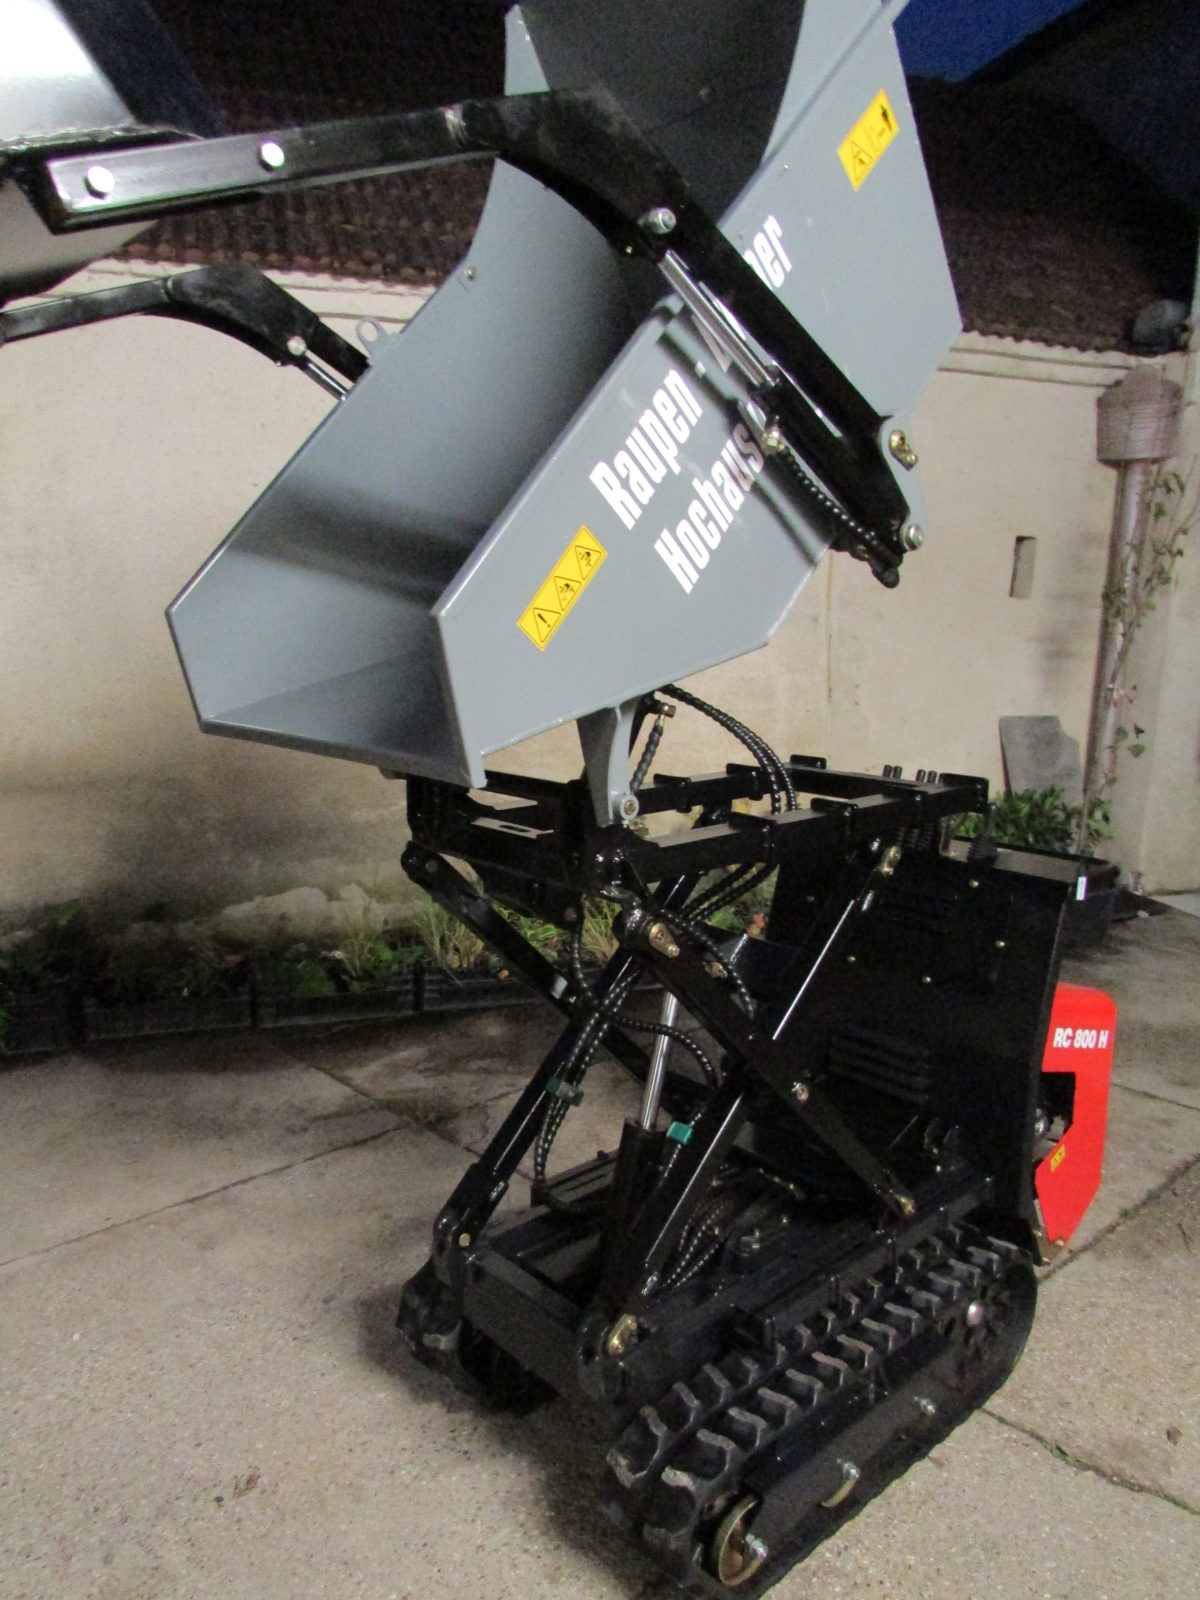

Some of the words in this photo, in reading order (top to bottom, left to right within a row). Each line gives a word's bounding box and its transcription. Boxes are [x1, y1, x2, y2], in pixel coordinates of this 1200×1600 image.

[589, 369, 703, 531] Raupen
[654, 424, 764, 594] Hochaus
[1053, 1026, 1073, 1048] RC
[1073, 1028, 1097, 1049] 800
[1097, 1029, 1110, 1049] H
